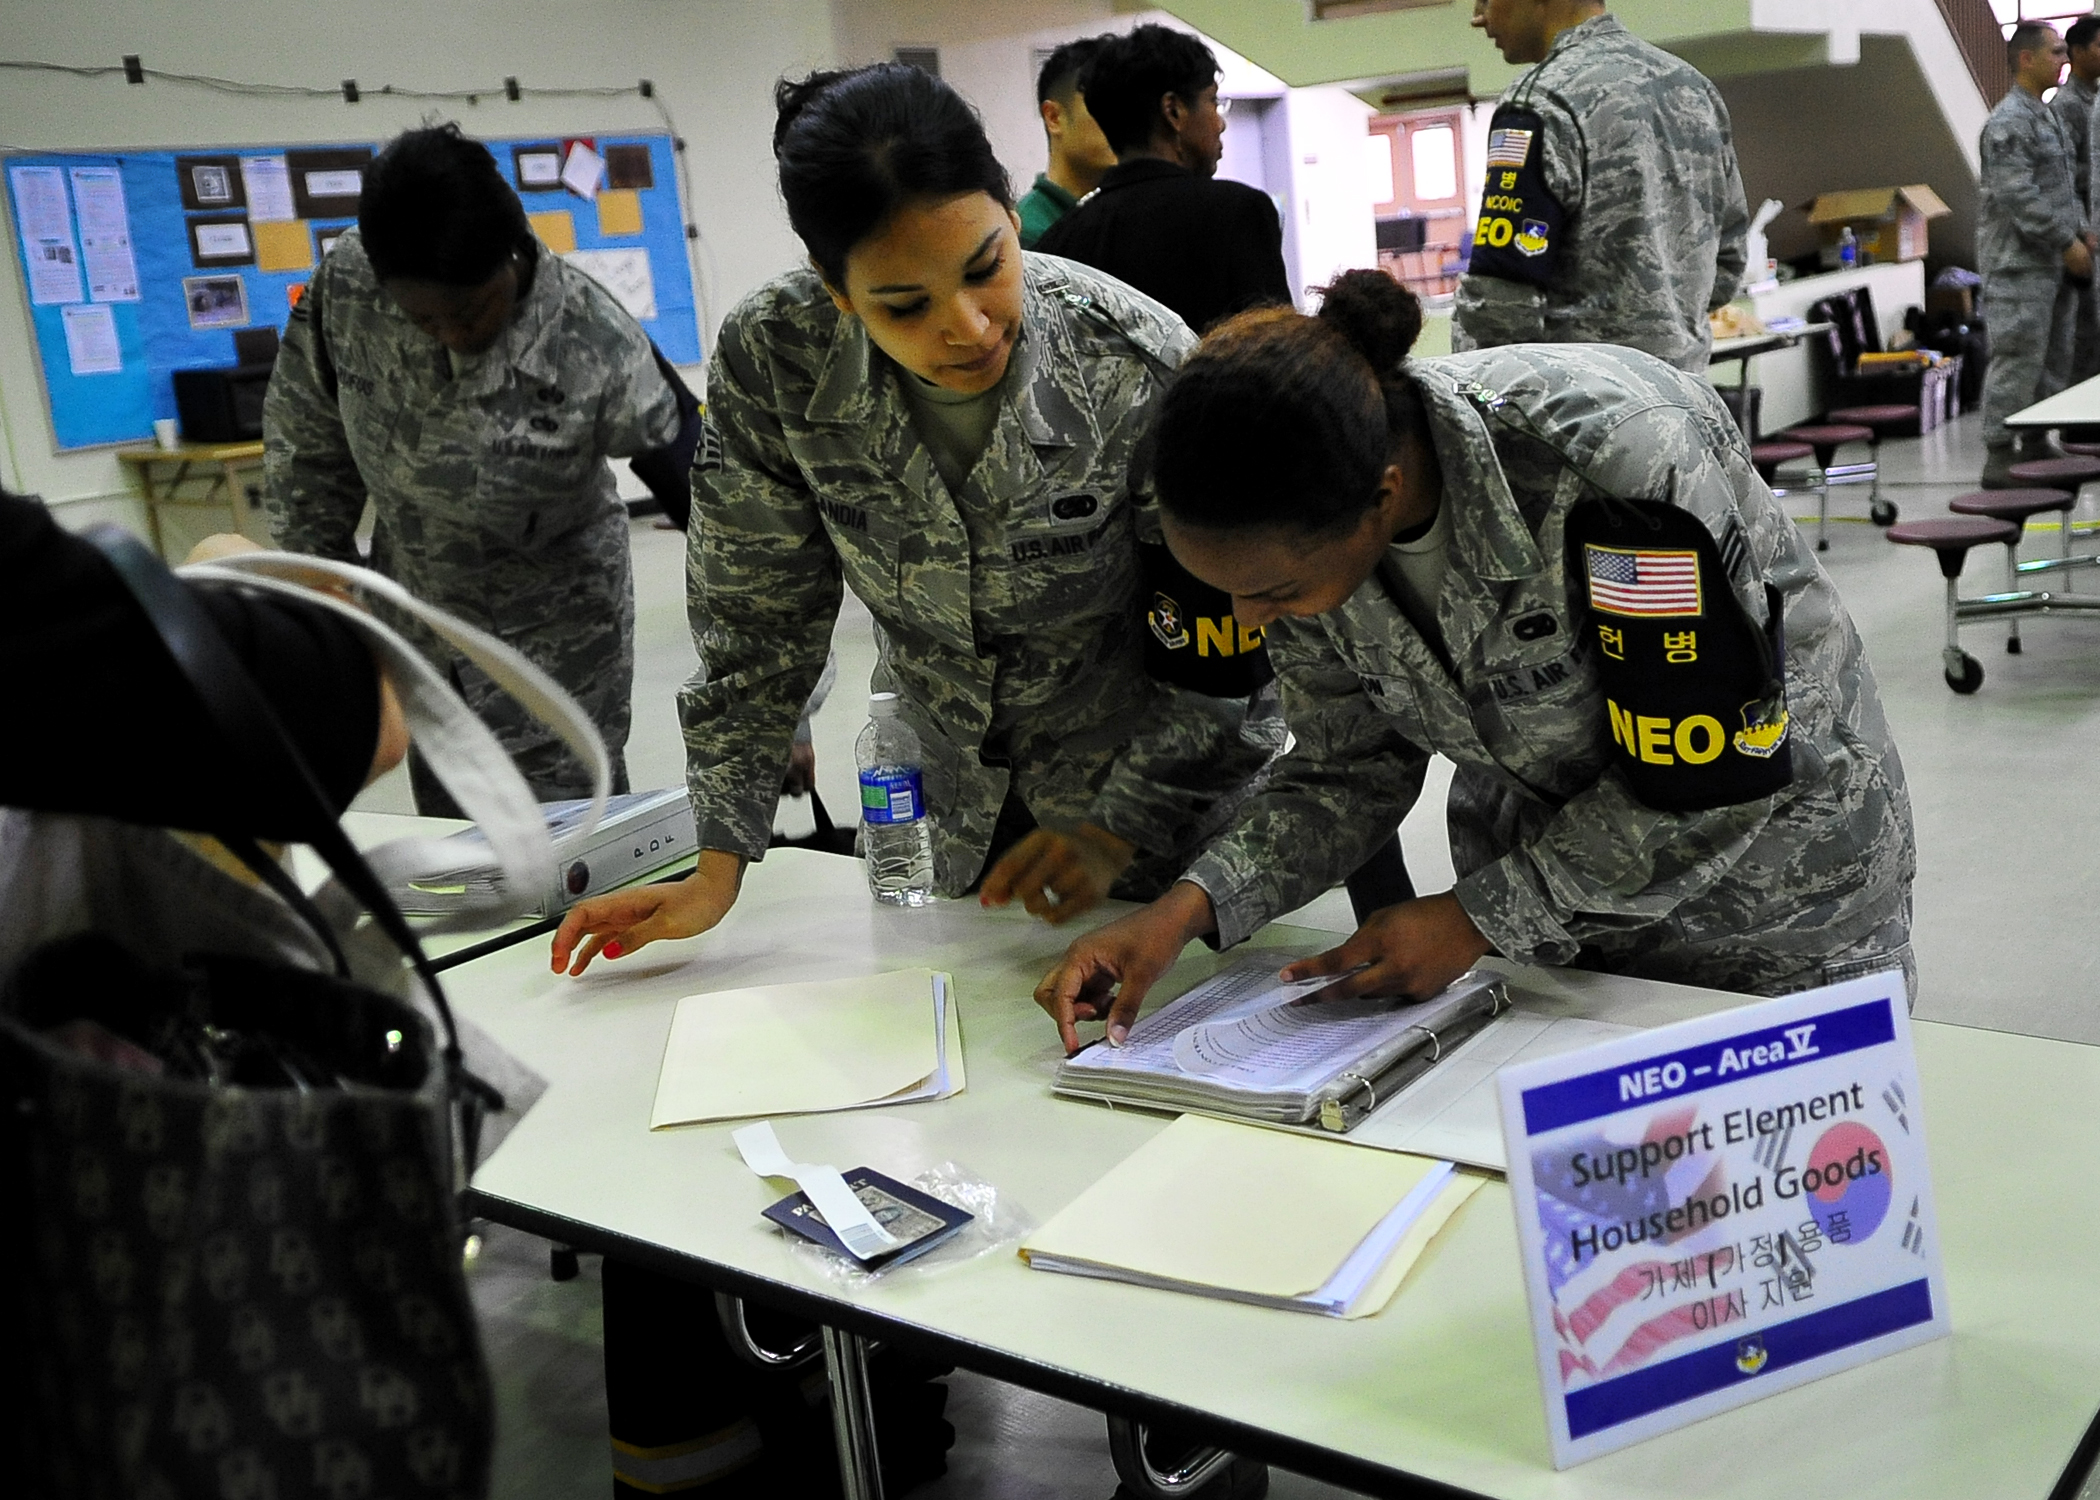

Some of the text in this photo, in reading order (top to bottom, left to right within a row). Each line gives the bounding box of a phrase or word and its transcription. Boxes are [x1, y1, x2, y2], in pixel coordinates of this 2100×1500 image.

[1486, 195, 1524, 213] NCOIC
[1474, 216, 1514, 248] EO
[817, 497, 868, 531] ANDIA
[1011, 540, 1047, 562] U.S.
[1051, 535, 1086, 556] AIR
[1195, 615, 1267, 657] NE
[1663, 630, 1698, 663] 병
[1360, 676, 1385, 697] ON
[1491, 663, 1570, 700] U.S. AIR
[1607, 698, 1726, 766] NEO
[1619, 1061, 1687, 1101] NEO
[1570, 1082, 1864, 1189] Support Element
[1570, 1146, 1882, 1262] Household Goods
